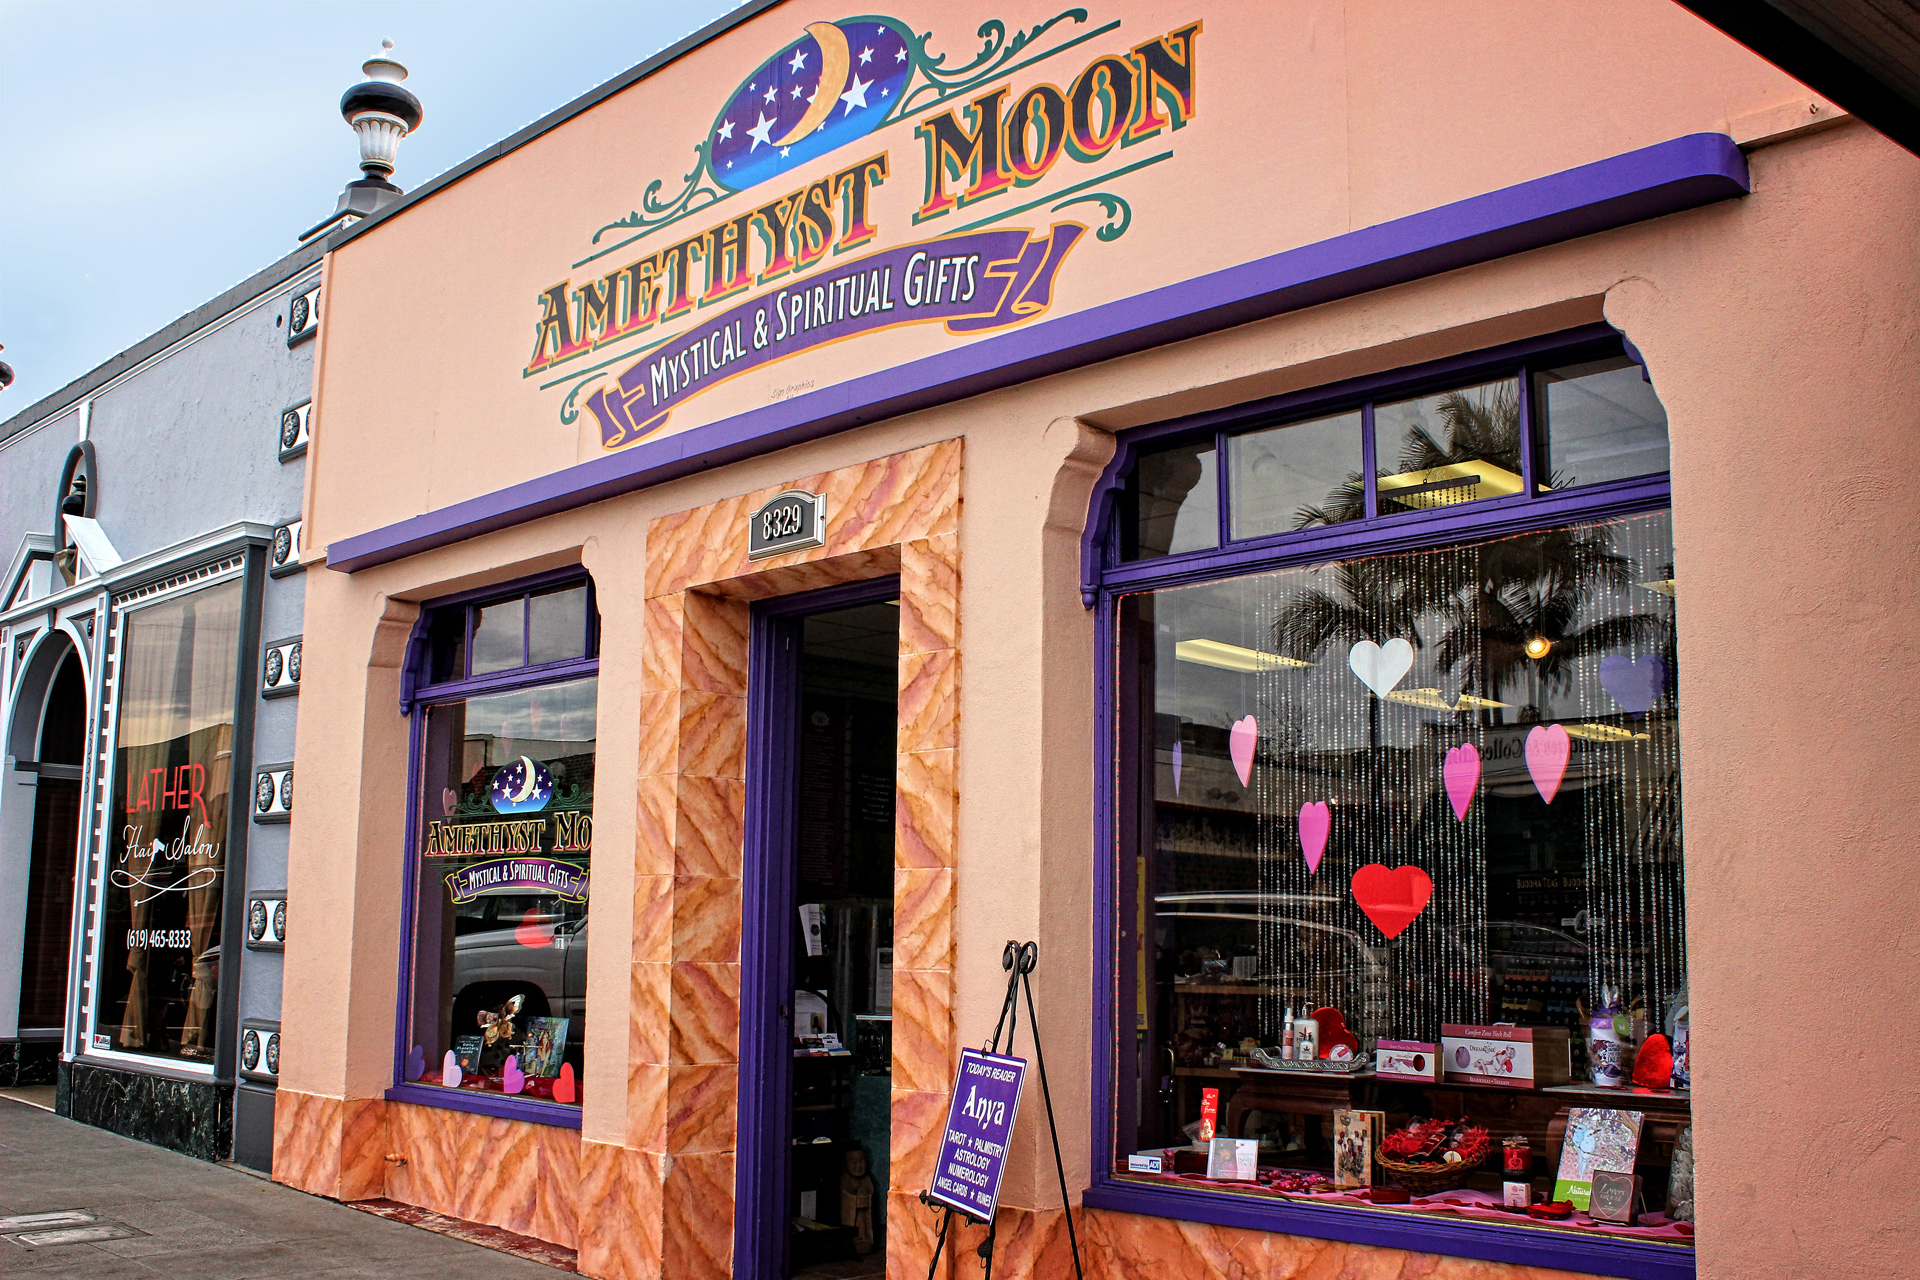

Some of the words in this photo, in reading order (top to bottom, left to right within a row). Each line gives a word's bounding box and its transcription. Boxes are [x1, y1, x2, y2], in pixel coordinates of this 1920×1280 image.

[523, 150, 890, 379] AMETHYST
[912, 18, 1203, 226] MOON
[649, 320, 747, 407] MYSTICAL
[752, 308, 769, 351] &
[775, 266, 894, 342] SPIRITUAL
[903, 251, 979, 308] GIFTS
[763, 504, 801, 540] 8329
[84, 718, 95, 794] 8333
[126, 763, 212, 829] LATHER
[165, 814, 220, 861] Salon
[424, 819, 546, 857] AMETHYST
[468, 865, 502, 891] MYSTICAL
[502, 864, 509, 880] &
[510, 861, 546, 883] SPIRITUAL
[547, 863, 569, 889] GIFTS
[1516, 878, 1541, 889] BUDDHA
[1543, 877, 1558, 888] TEAS
[127, 928, 149, 950] (619)
[149, 929, 192, 948] 465-8333
[966, 1062, 992, 1078] TODAY'S
[991, 1066, 1016, 1083] READER
[961, 1084, 1006, 1130] Anya
[948, 1128, 967, 1146] TAROT
[974, 1138, 1004, 1159] PALMISTRY
[953, 1147, 991, 1171] ASTROLOGY
[937, 1175, 953, 1191] ANGEL
[952, 1181, 968, 1198] CARDS
[976, 1193, 992, 1208] RUNES
[948, 1162, 990, 1188] NUMEROLOGY
